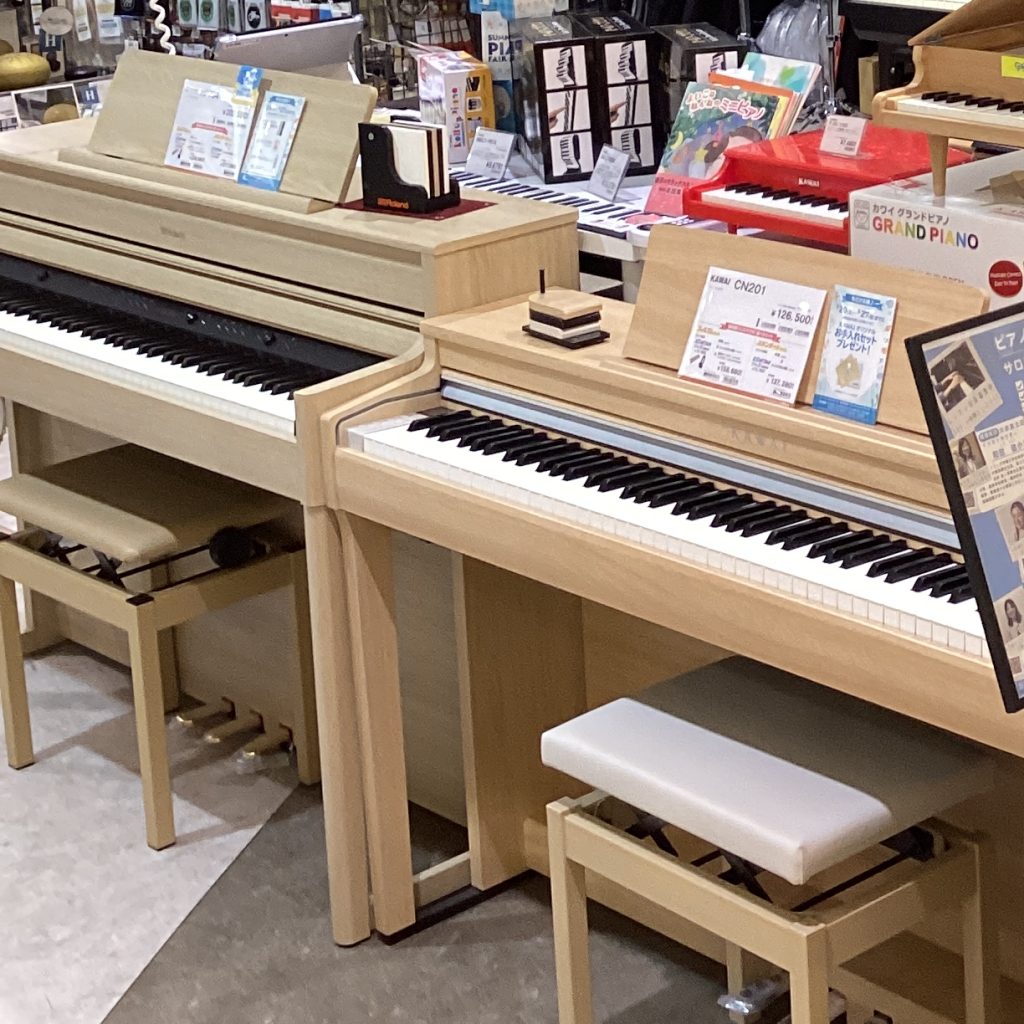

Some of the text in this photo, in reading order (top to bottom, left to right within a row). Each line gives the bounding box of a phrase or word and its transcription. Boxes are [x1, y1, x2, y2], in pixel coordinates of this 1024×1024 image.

[873, 204, 950, 226] カワイ グランドピアノ
[872, 216, 980, 250] GRAND PIANO
[733, 279, 767, 296] CN201
[834, 328, 878, 346] お手入れセット
[835, 339, 872, 356] プレゼント!
